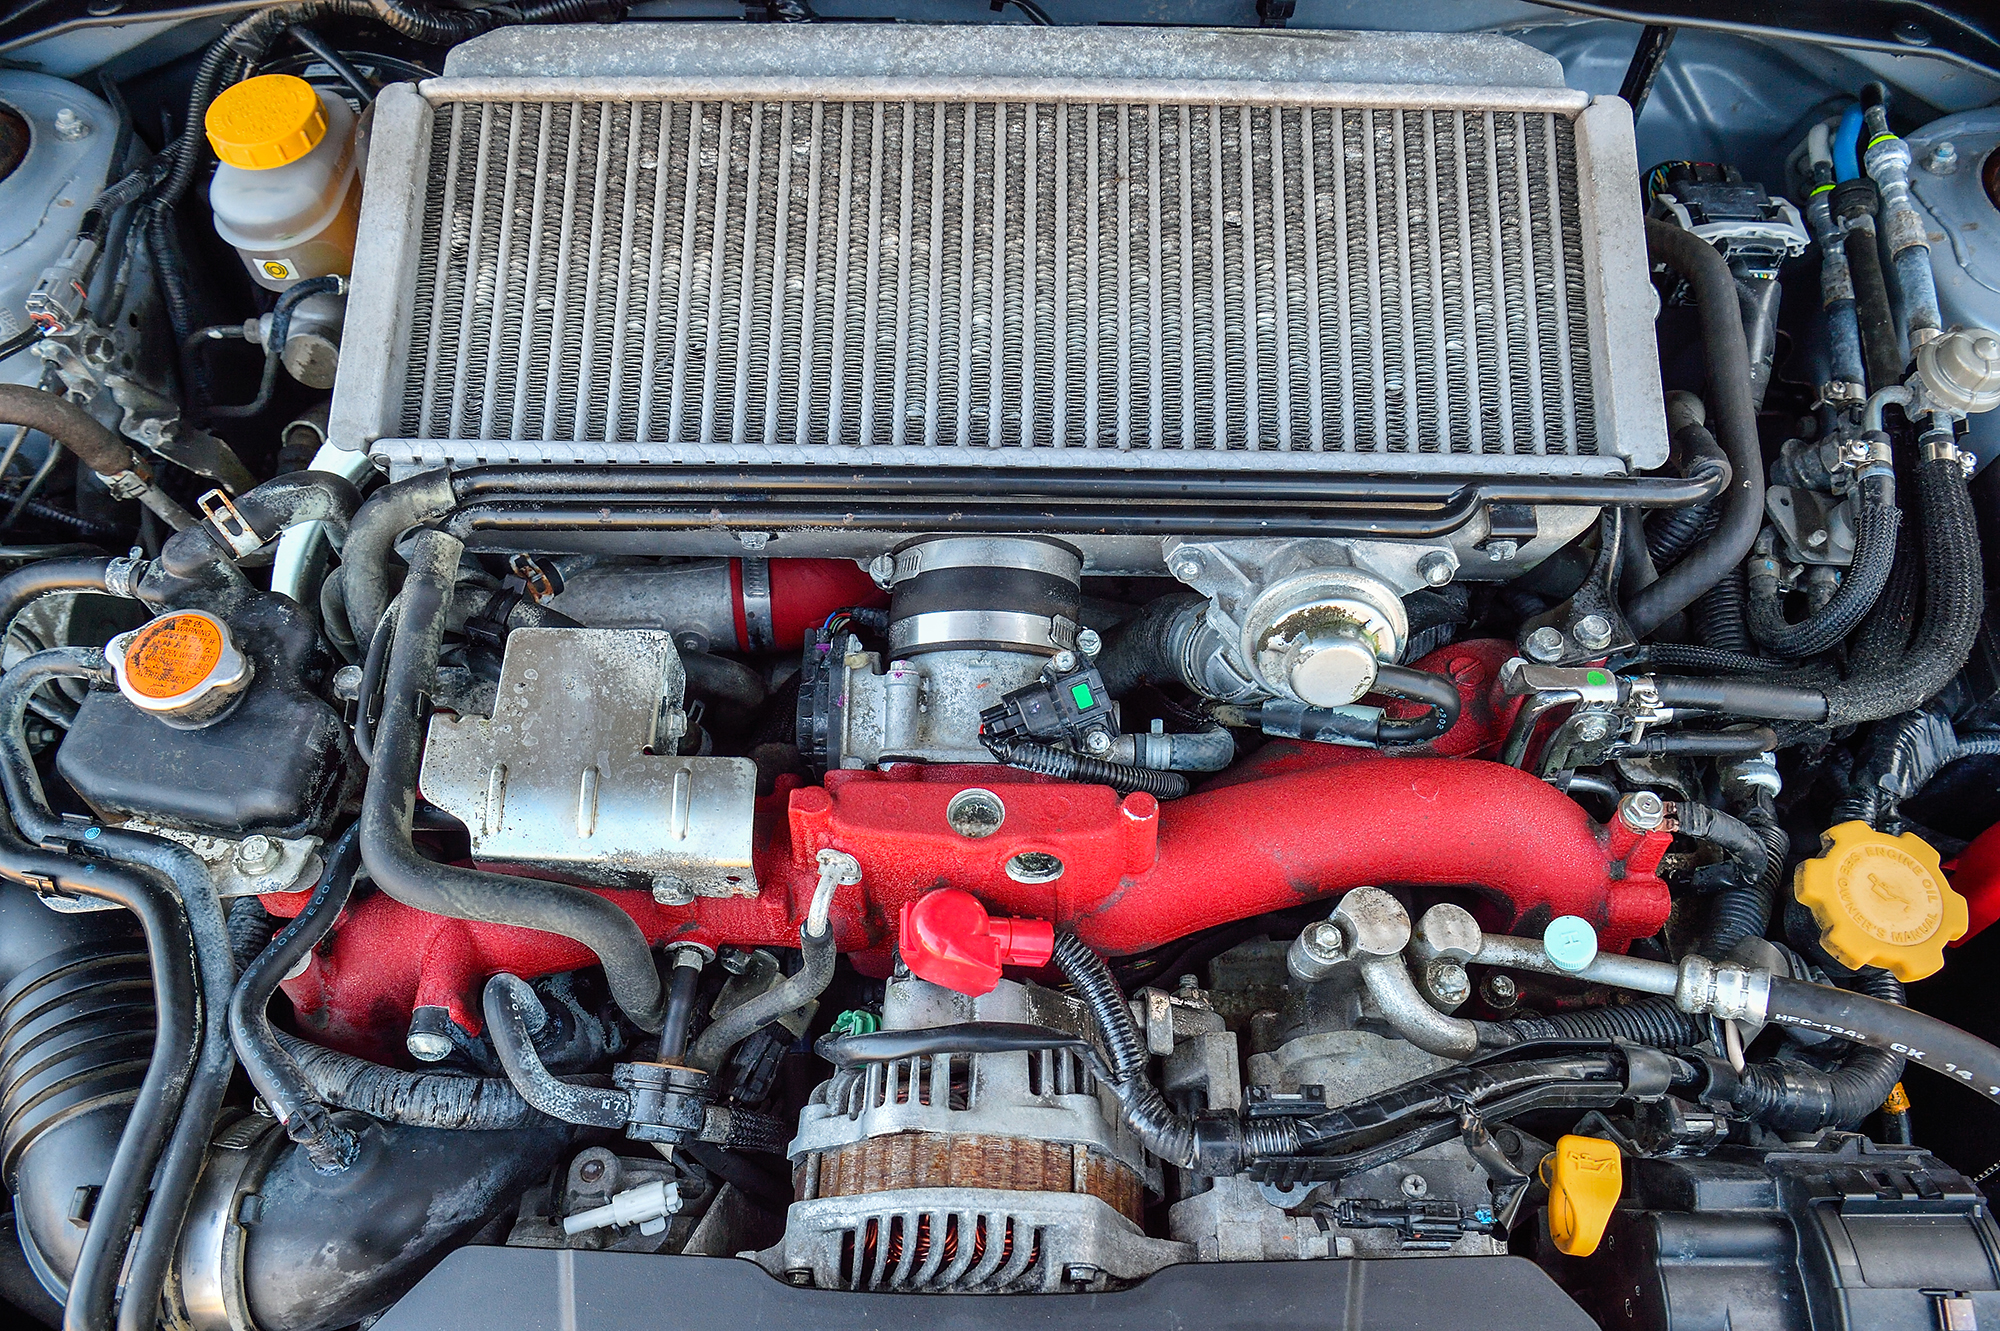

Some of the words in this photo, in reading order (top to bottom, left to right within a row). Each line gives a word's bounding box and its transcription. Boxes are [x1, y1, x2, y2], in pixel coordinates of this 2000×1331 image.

[177, 625, 211, 636] WARNING
[1840, 852, 1863, 876] SEE
[1865, 846, 1924, 877] ENGINE
[1922, 878, 1939, 904] OIL
[1837, 877, 1887, 939] OWNER'S
[1891, 912, 1939, 943] MANUAL
[1774, 1013, 1867, 1040] HFC-134a
[1890, 1042, 1926, 1060] GK
